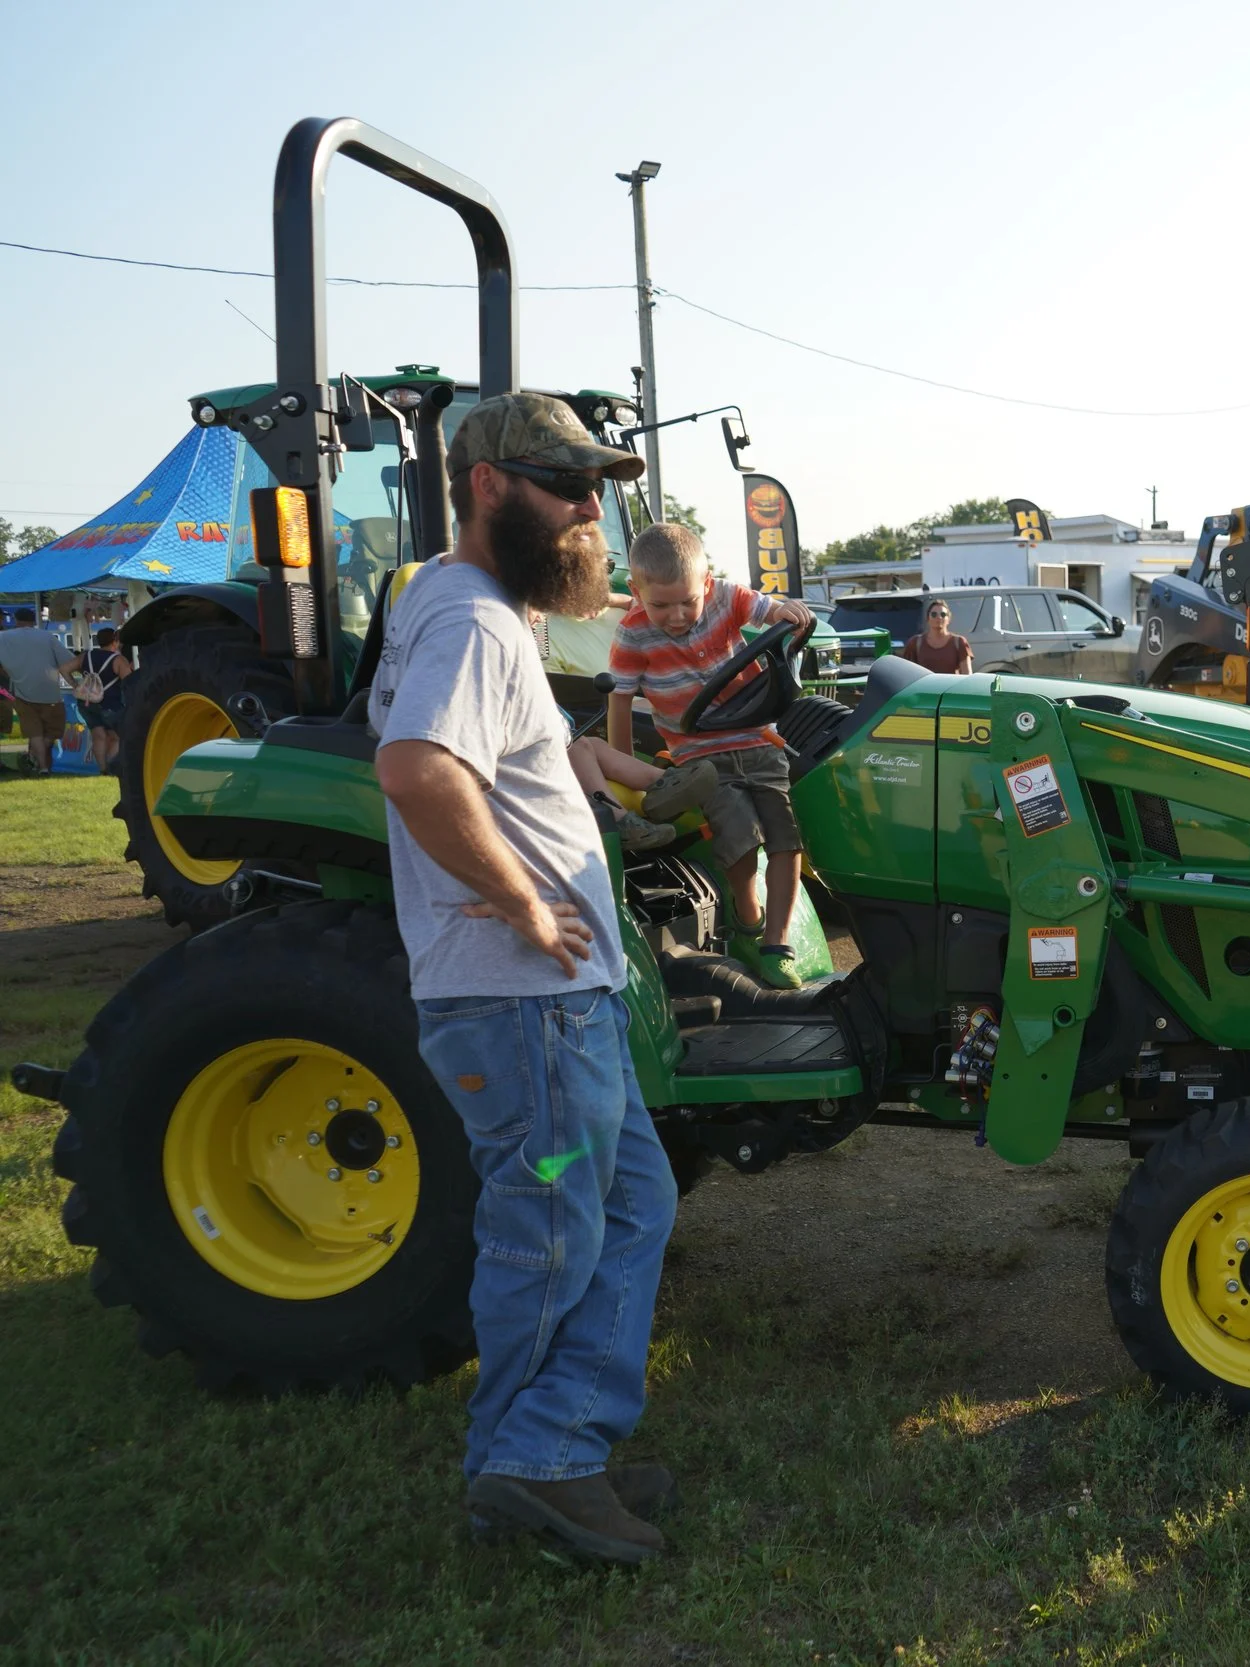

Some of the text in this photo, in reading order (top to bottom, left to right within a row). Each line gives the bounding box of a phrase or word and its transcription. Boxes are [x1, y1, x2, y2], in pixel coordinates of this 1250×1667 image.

[1180, 604, 1198, 621] 330G
[863, 752, 920, 769] Atlantic Tractor
[1013, 755, 1049, 775] WARNING
[1037, 928, 1074, 937] WARNING
